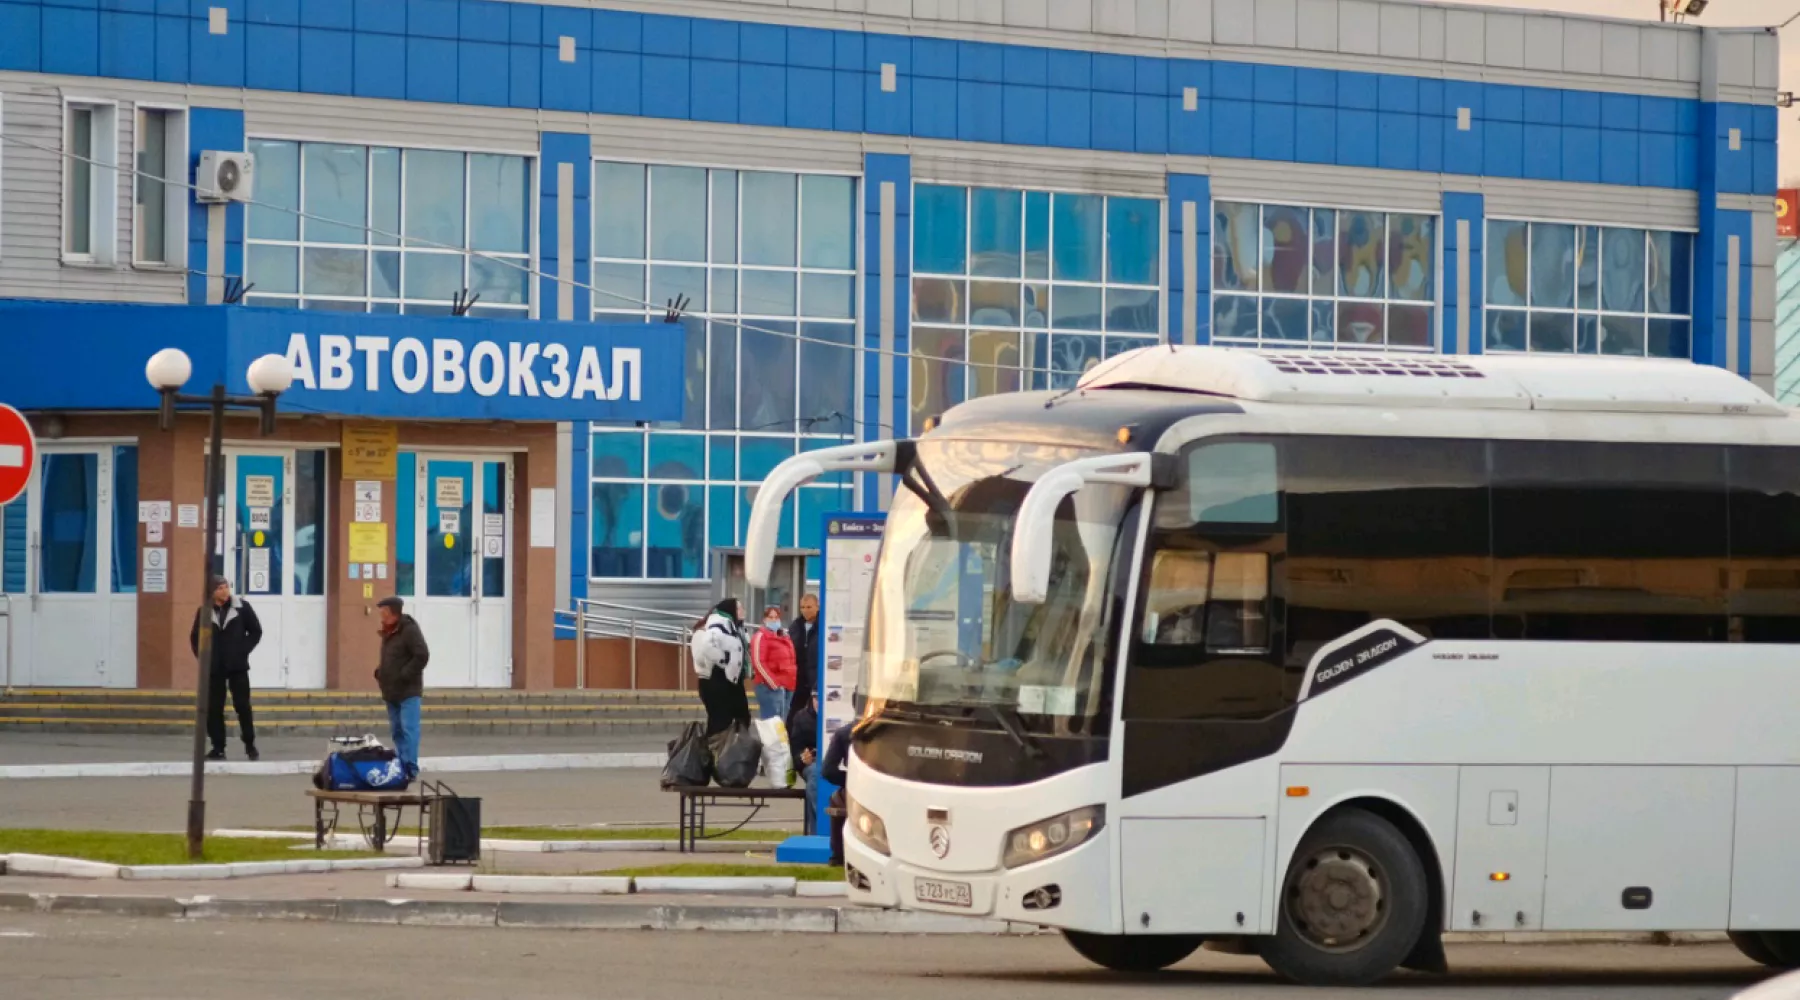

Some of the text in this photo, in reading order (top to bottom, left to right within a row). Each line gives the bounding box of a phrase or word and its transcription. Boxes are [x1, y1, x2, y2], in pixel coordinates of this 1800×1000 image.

[285, 332, 641, 401] АВТОВОКЗАЛ
[1317, 637, 1398, 682] GOLDEN DRAGON
[907, 745, 983, 763] GOLDEN DRAGON
